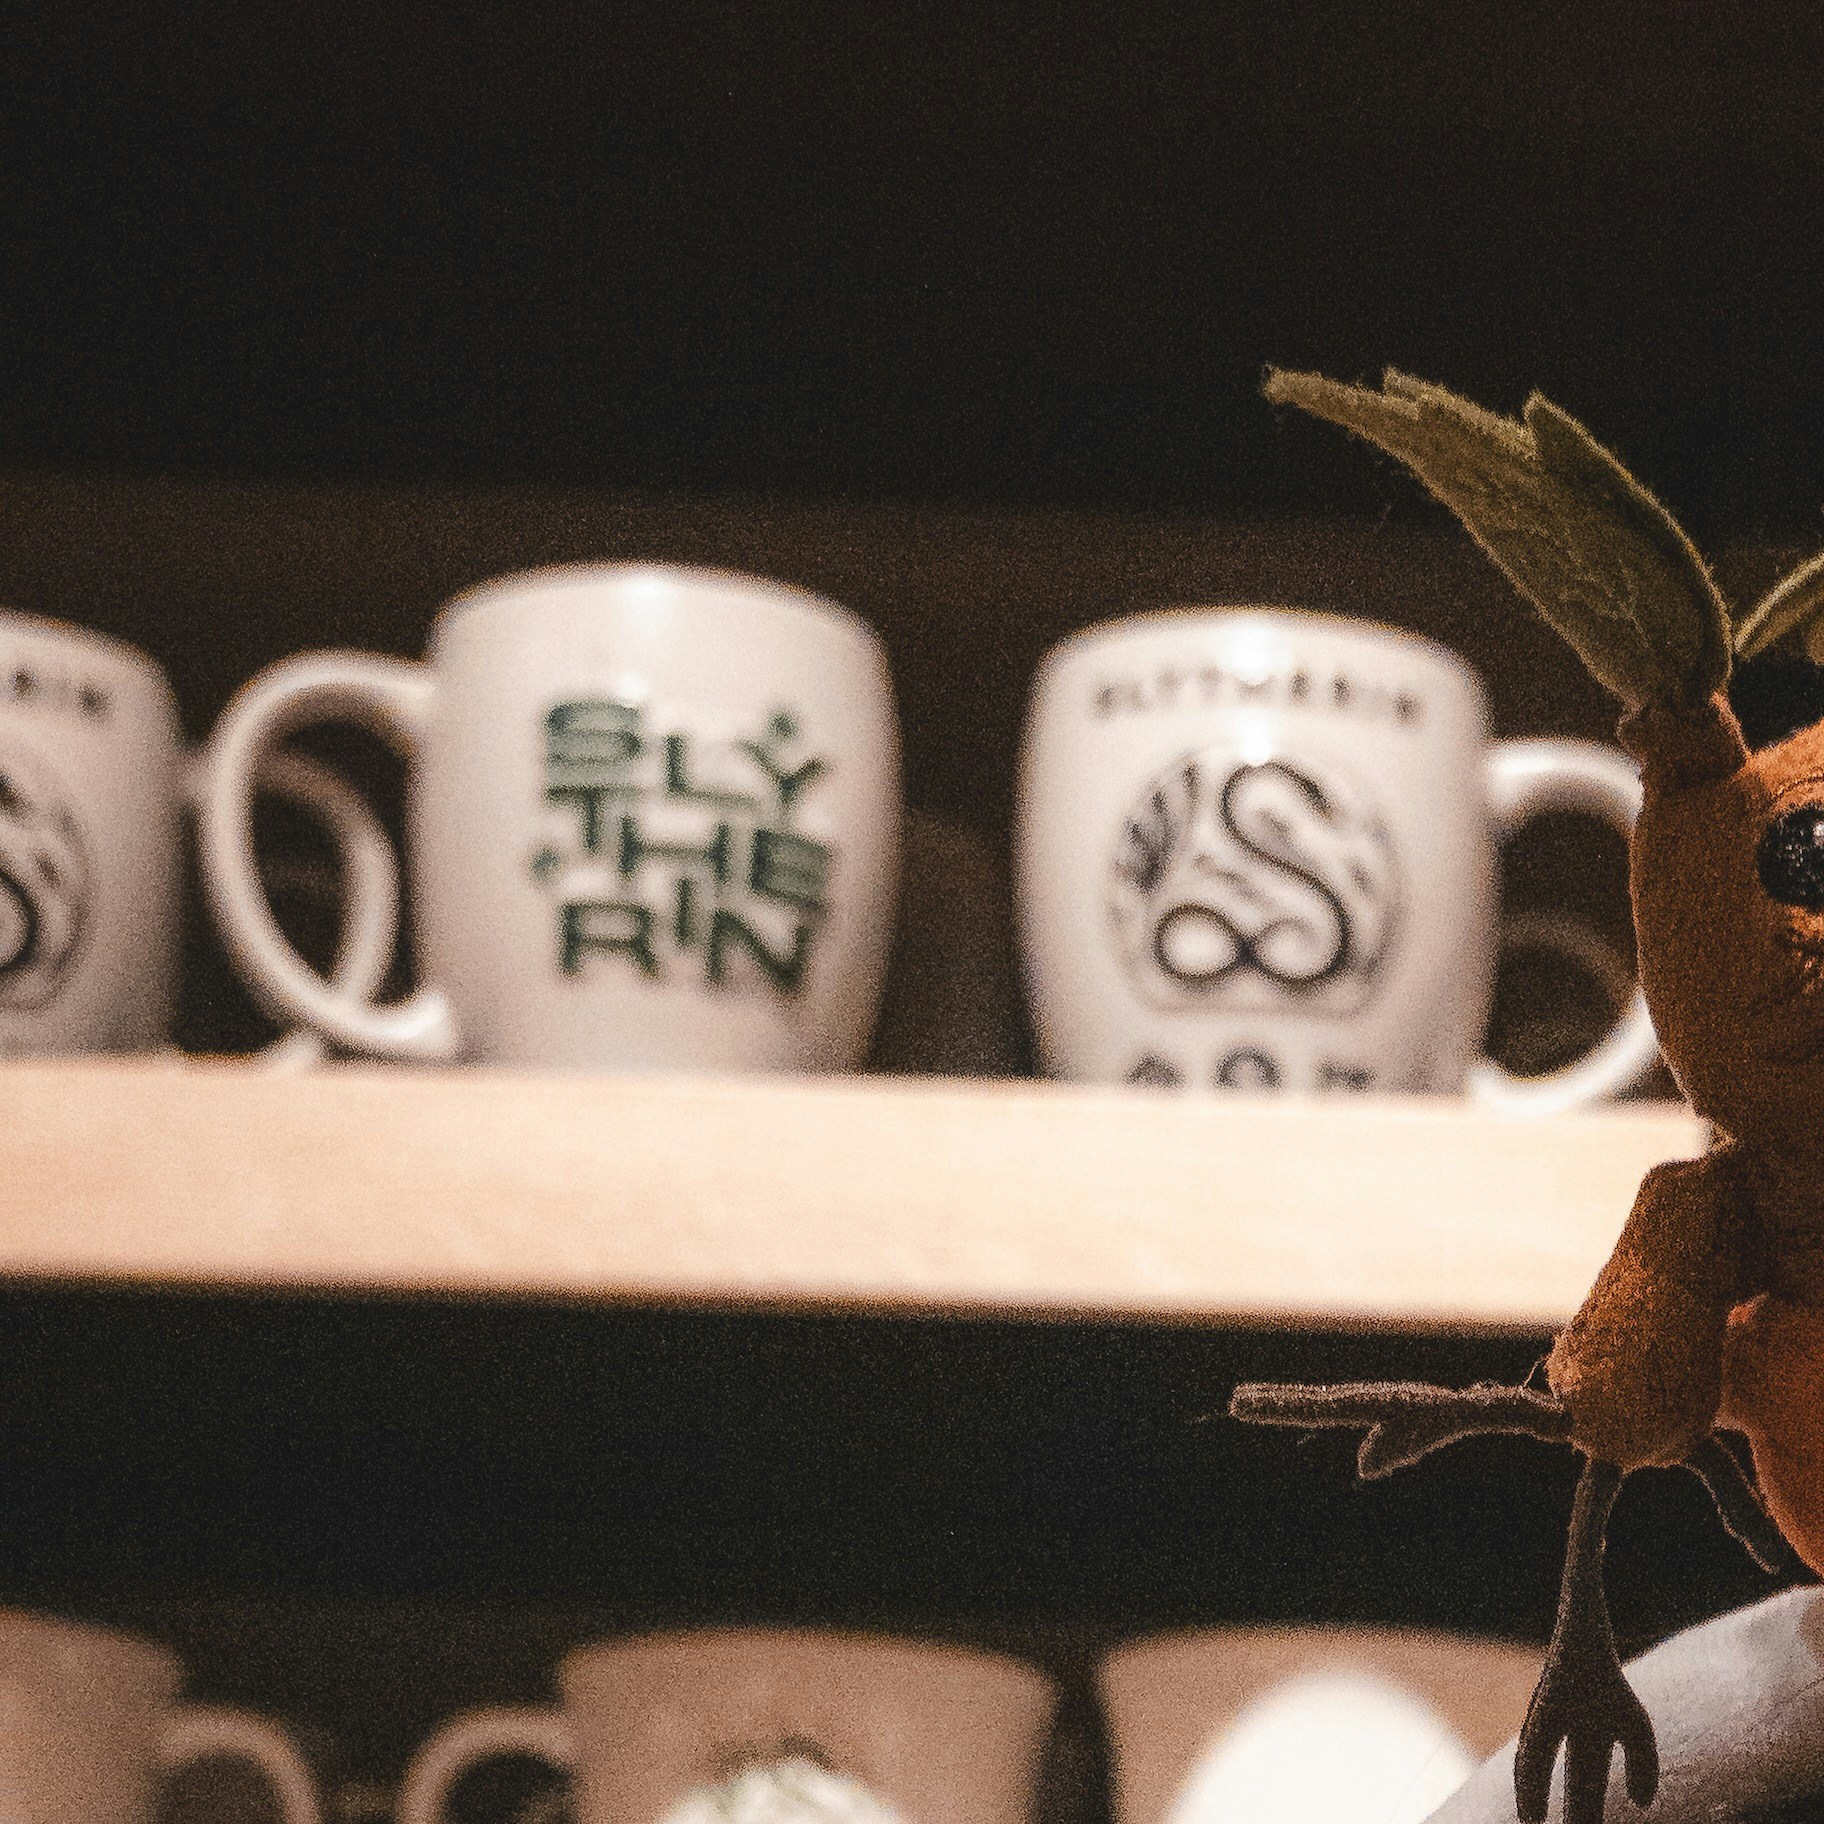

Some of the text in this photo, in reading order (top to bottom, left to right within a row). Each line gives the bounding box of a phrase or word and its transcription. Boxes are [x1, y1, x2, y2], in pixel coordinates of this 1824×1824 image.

[543, 700, 830, 810] SLY
[544, 786, 832, 912] THE
[557, 876, 814, 992] RIN
